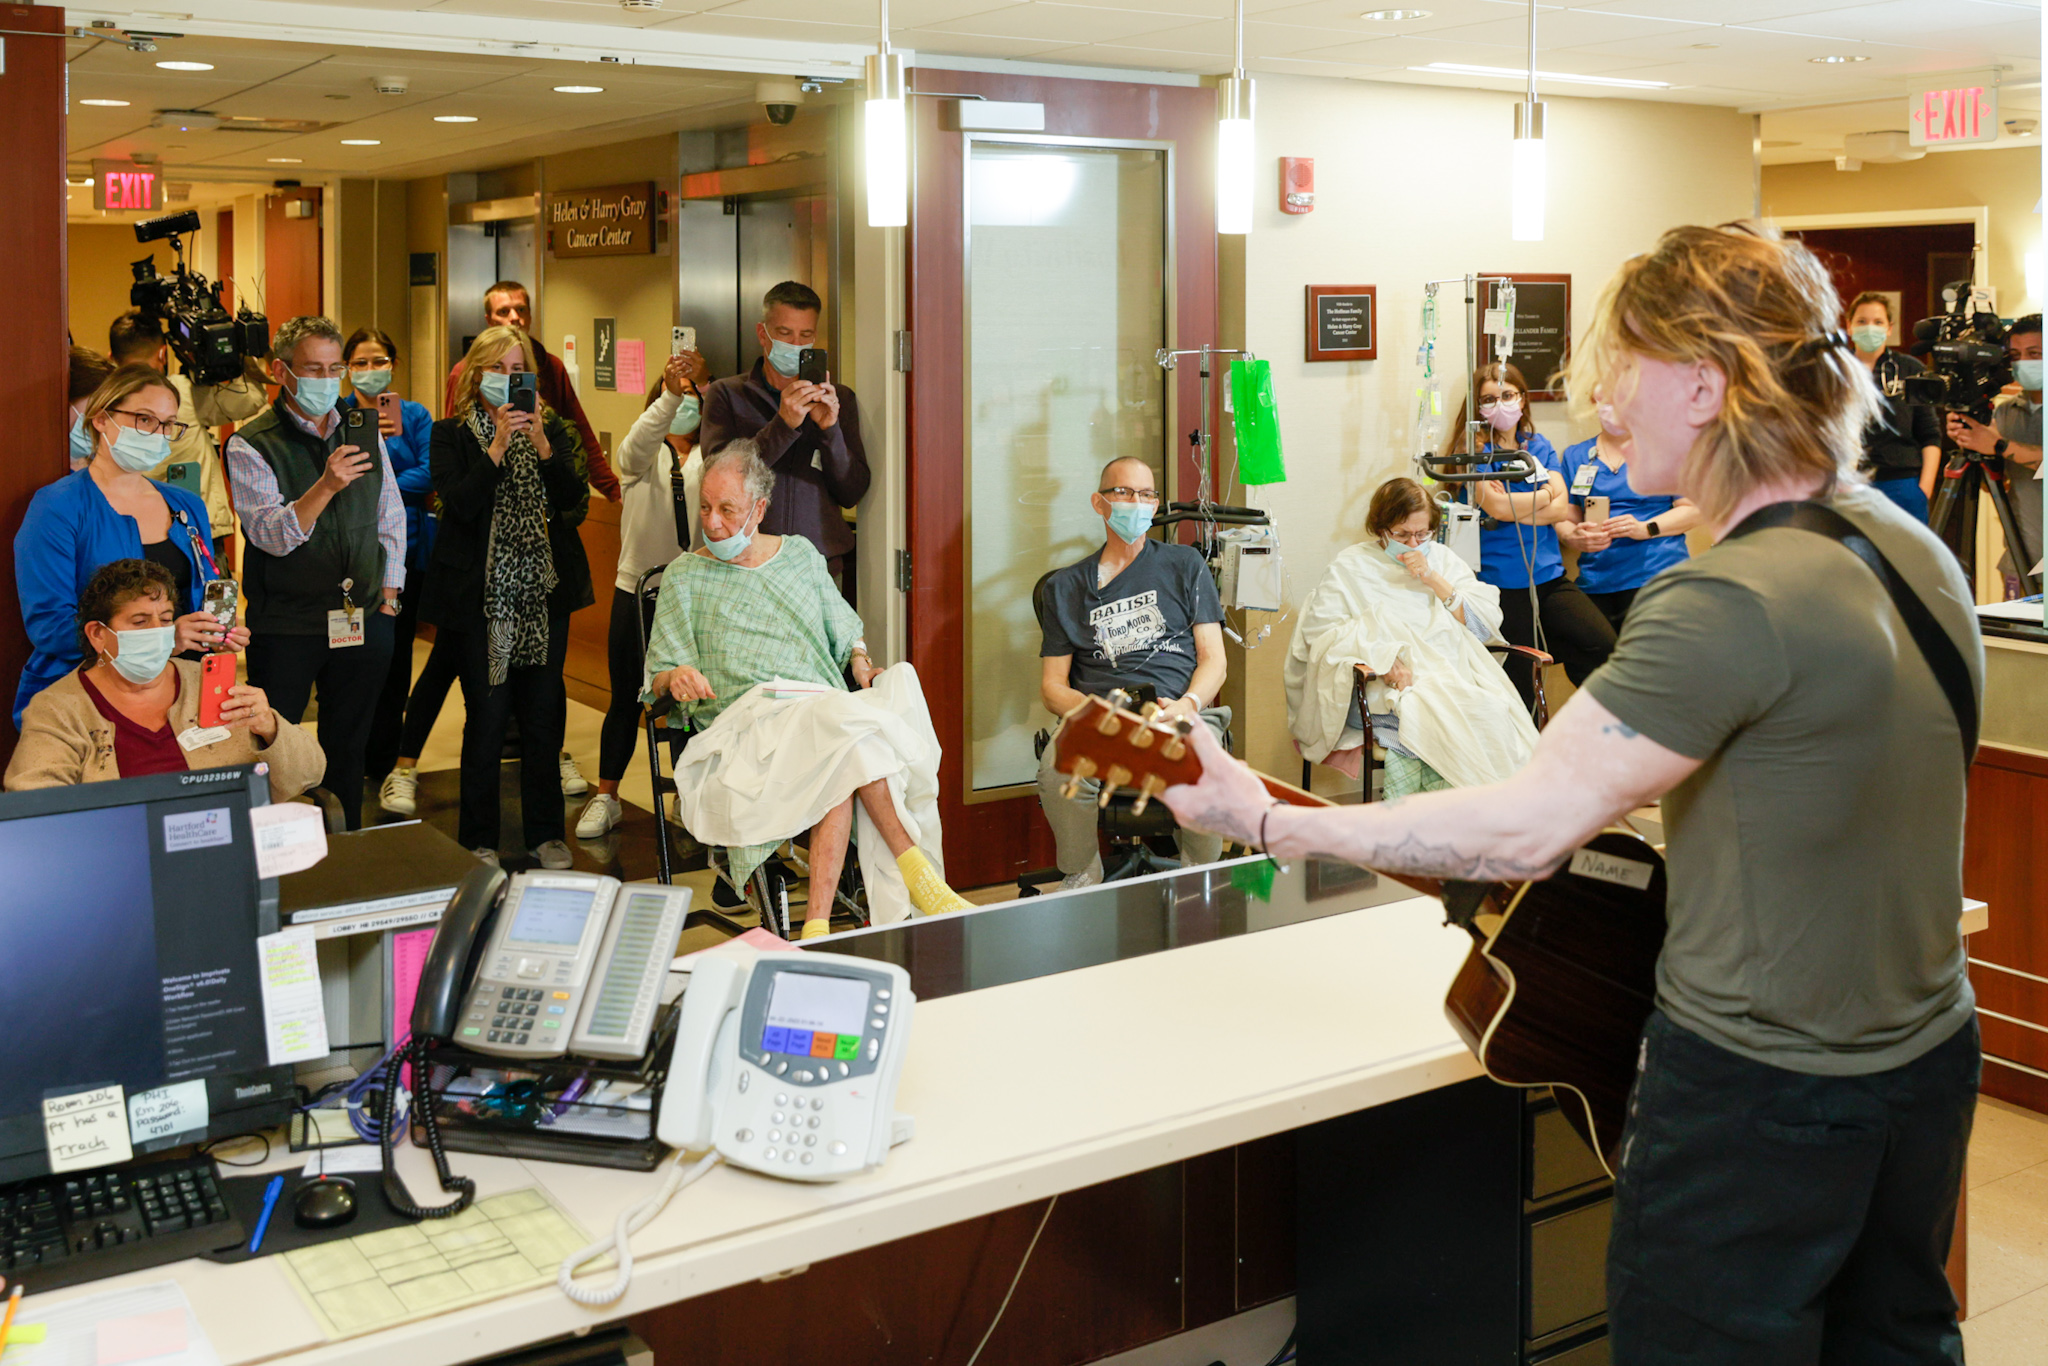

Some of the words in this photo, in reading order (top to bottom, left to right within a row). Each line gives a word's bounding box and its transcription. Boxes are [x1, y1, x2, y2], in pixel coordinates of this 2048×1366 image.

[1924, 87, 1984, 140] EXIT
[105, 172, 155, 209] EXIT
[553, 200, 578, 222] Helen
[592, 199, 620, 222] Harry
[621, 195, 646, 220] Gray
[567, 228, 598, 248] Cancer
[600, 225, 631, 246] Center
[1093, 593, 1154, 621] BALISE
[1108, 626, 1127, 638] FORD
[1125, 614, 1151, 635] MOTOR
[331, 635, 362, 644] DOCTOR
[168, 820, 206, 832] Hartford
[168, 829, 218, 841] HealthCare
[1581, 853, 1634, 879] NAME
[333, 924, 356, 933] LOBBY
[162, 976, 192, 984] Welcome
[163, 991, 195, 1002] Workflow
[48, 1099, 83, 1112] Room
[87, 1089, 114, 1104] 206
[73, 1113, 97, 1128] has
